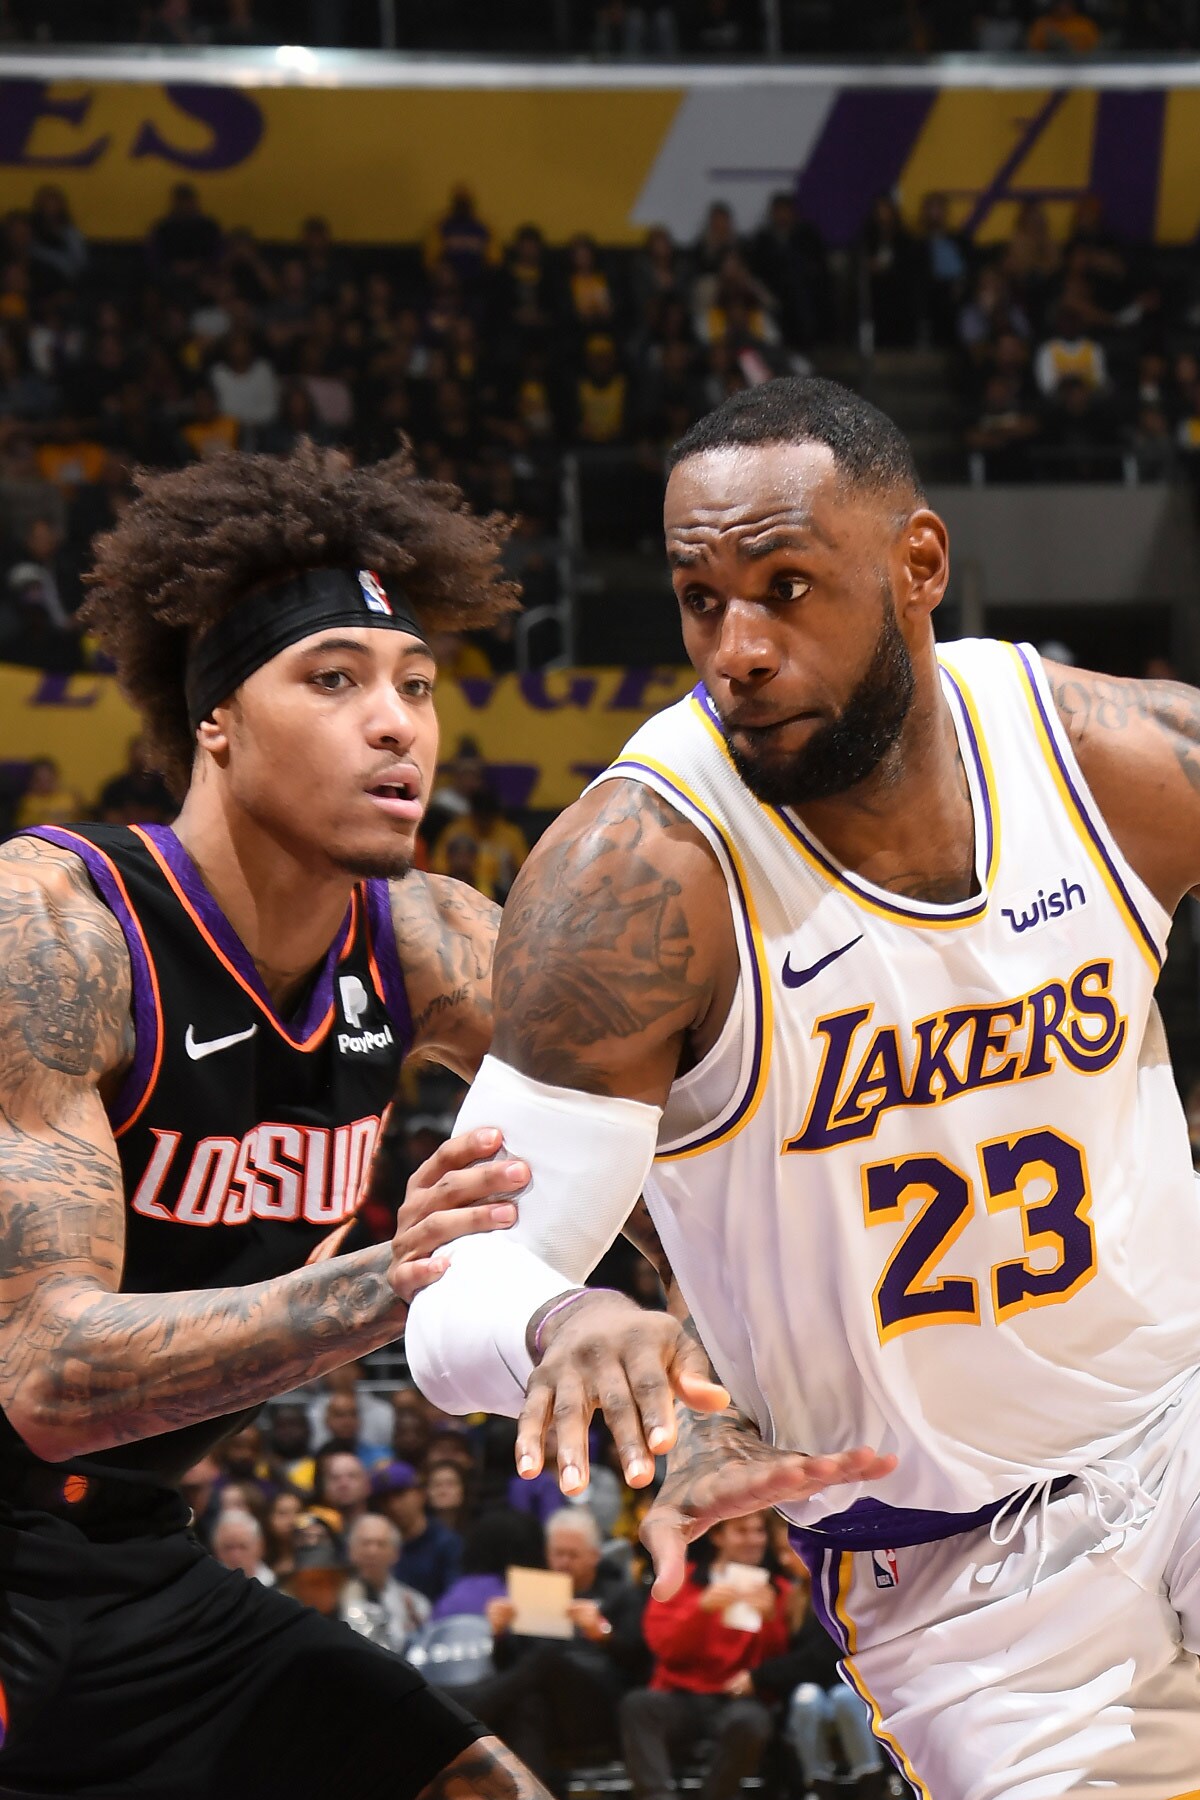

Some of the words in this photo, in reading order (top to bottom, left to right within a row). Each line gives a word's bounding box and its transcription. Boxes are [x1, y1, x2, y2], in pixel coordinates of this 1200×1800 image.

[1001, 877, 1086, 933] wish
[337, 1024, 394, 1055] PayPal
[781, 957, 1129, 1156] LAKERS
[861, 1125, 1099, 1346] 23
